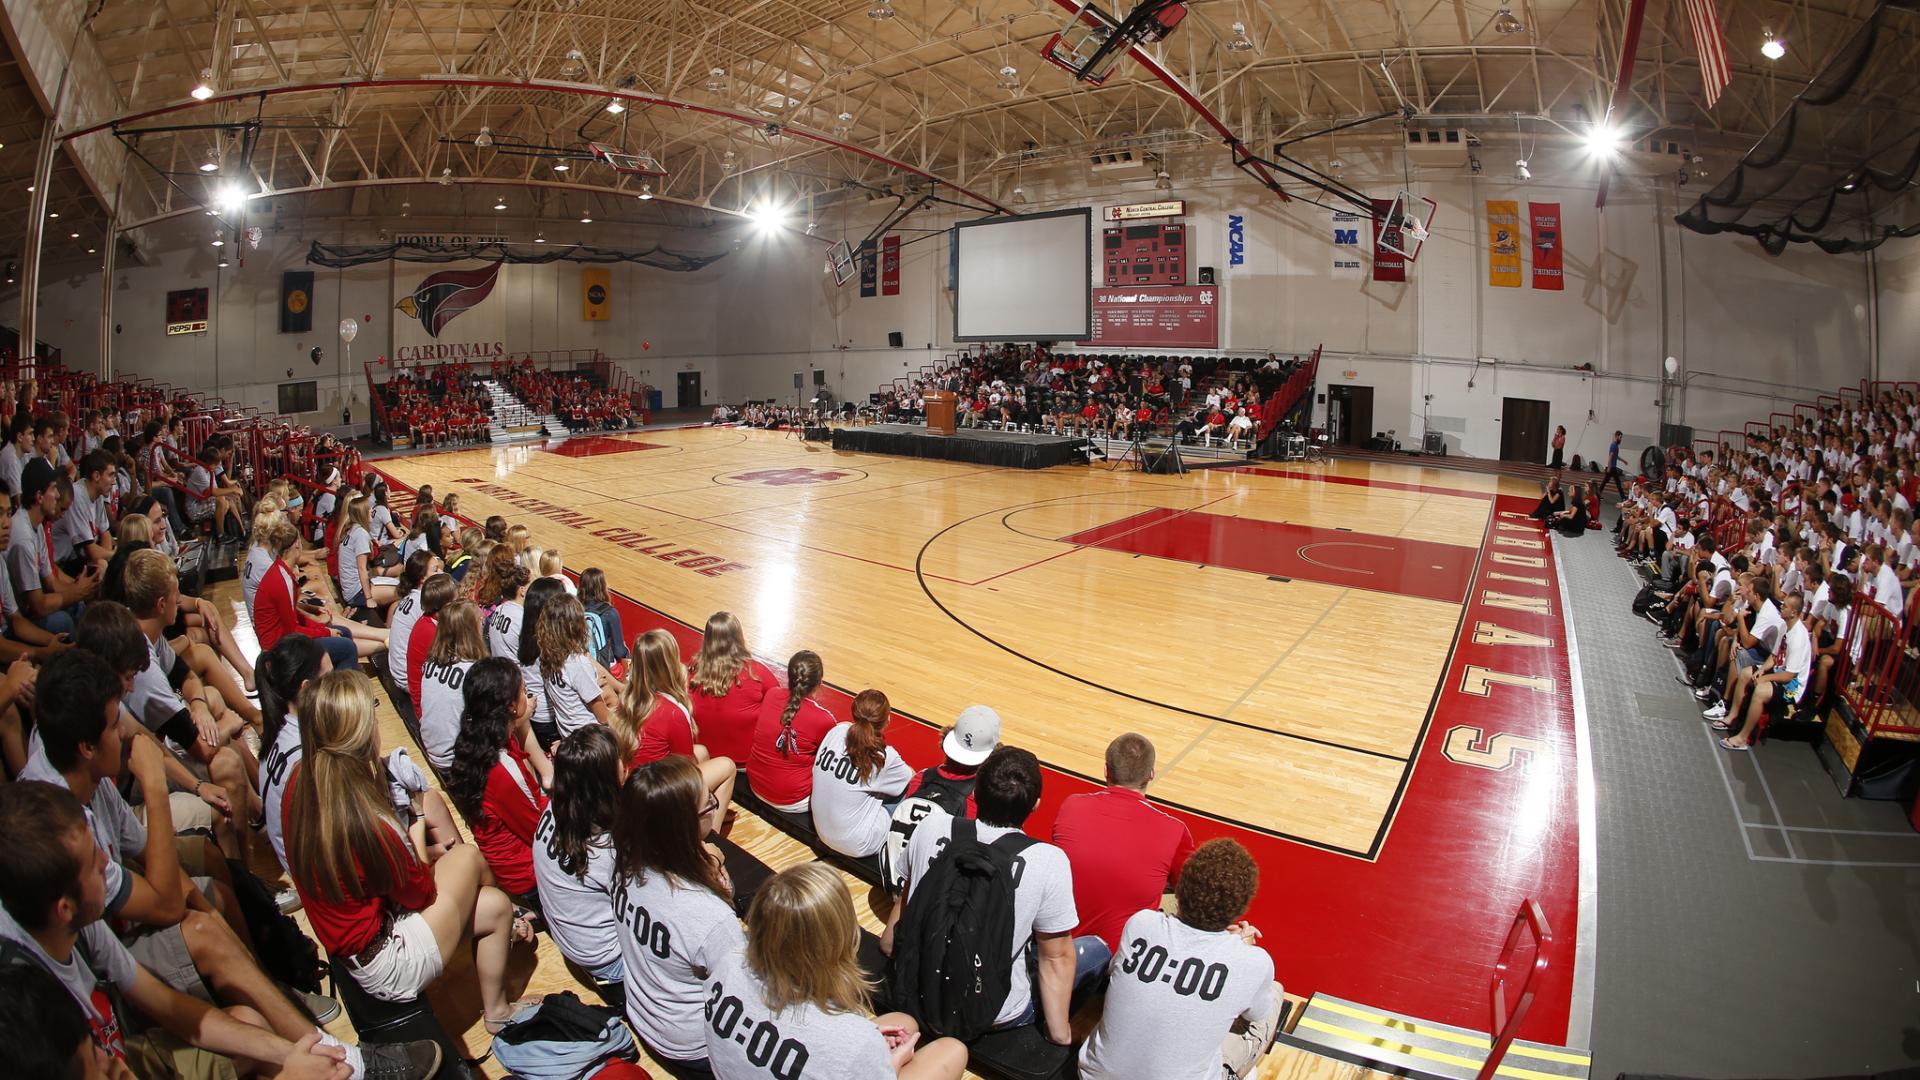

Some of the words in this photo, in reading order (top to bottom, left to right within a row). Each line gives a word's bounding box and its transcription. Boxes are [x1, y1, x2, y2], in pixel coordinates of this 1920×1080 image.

[1229, 215, 1244, 265] NCAA
[1334, 229, 1358, 244] M
[1139, 294, 1193, 303] Championships
[168, 324, 191, 333] PEPSI
[397, 342, 504, 360] CARDINALS
[509, 498, 607, 529] CENTRAL
[589, 527, 752, 577] COLLEGE
[1440, 511, 1557, 771] CARDINALS
[816, 746, 861, 785] 30:00
[1122, 937, 1229, 1002] 30:00
[705, 981, 809, 1080] 30:00
